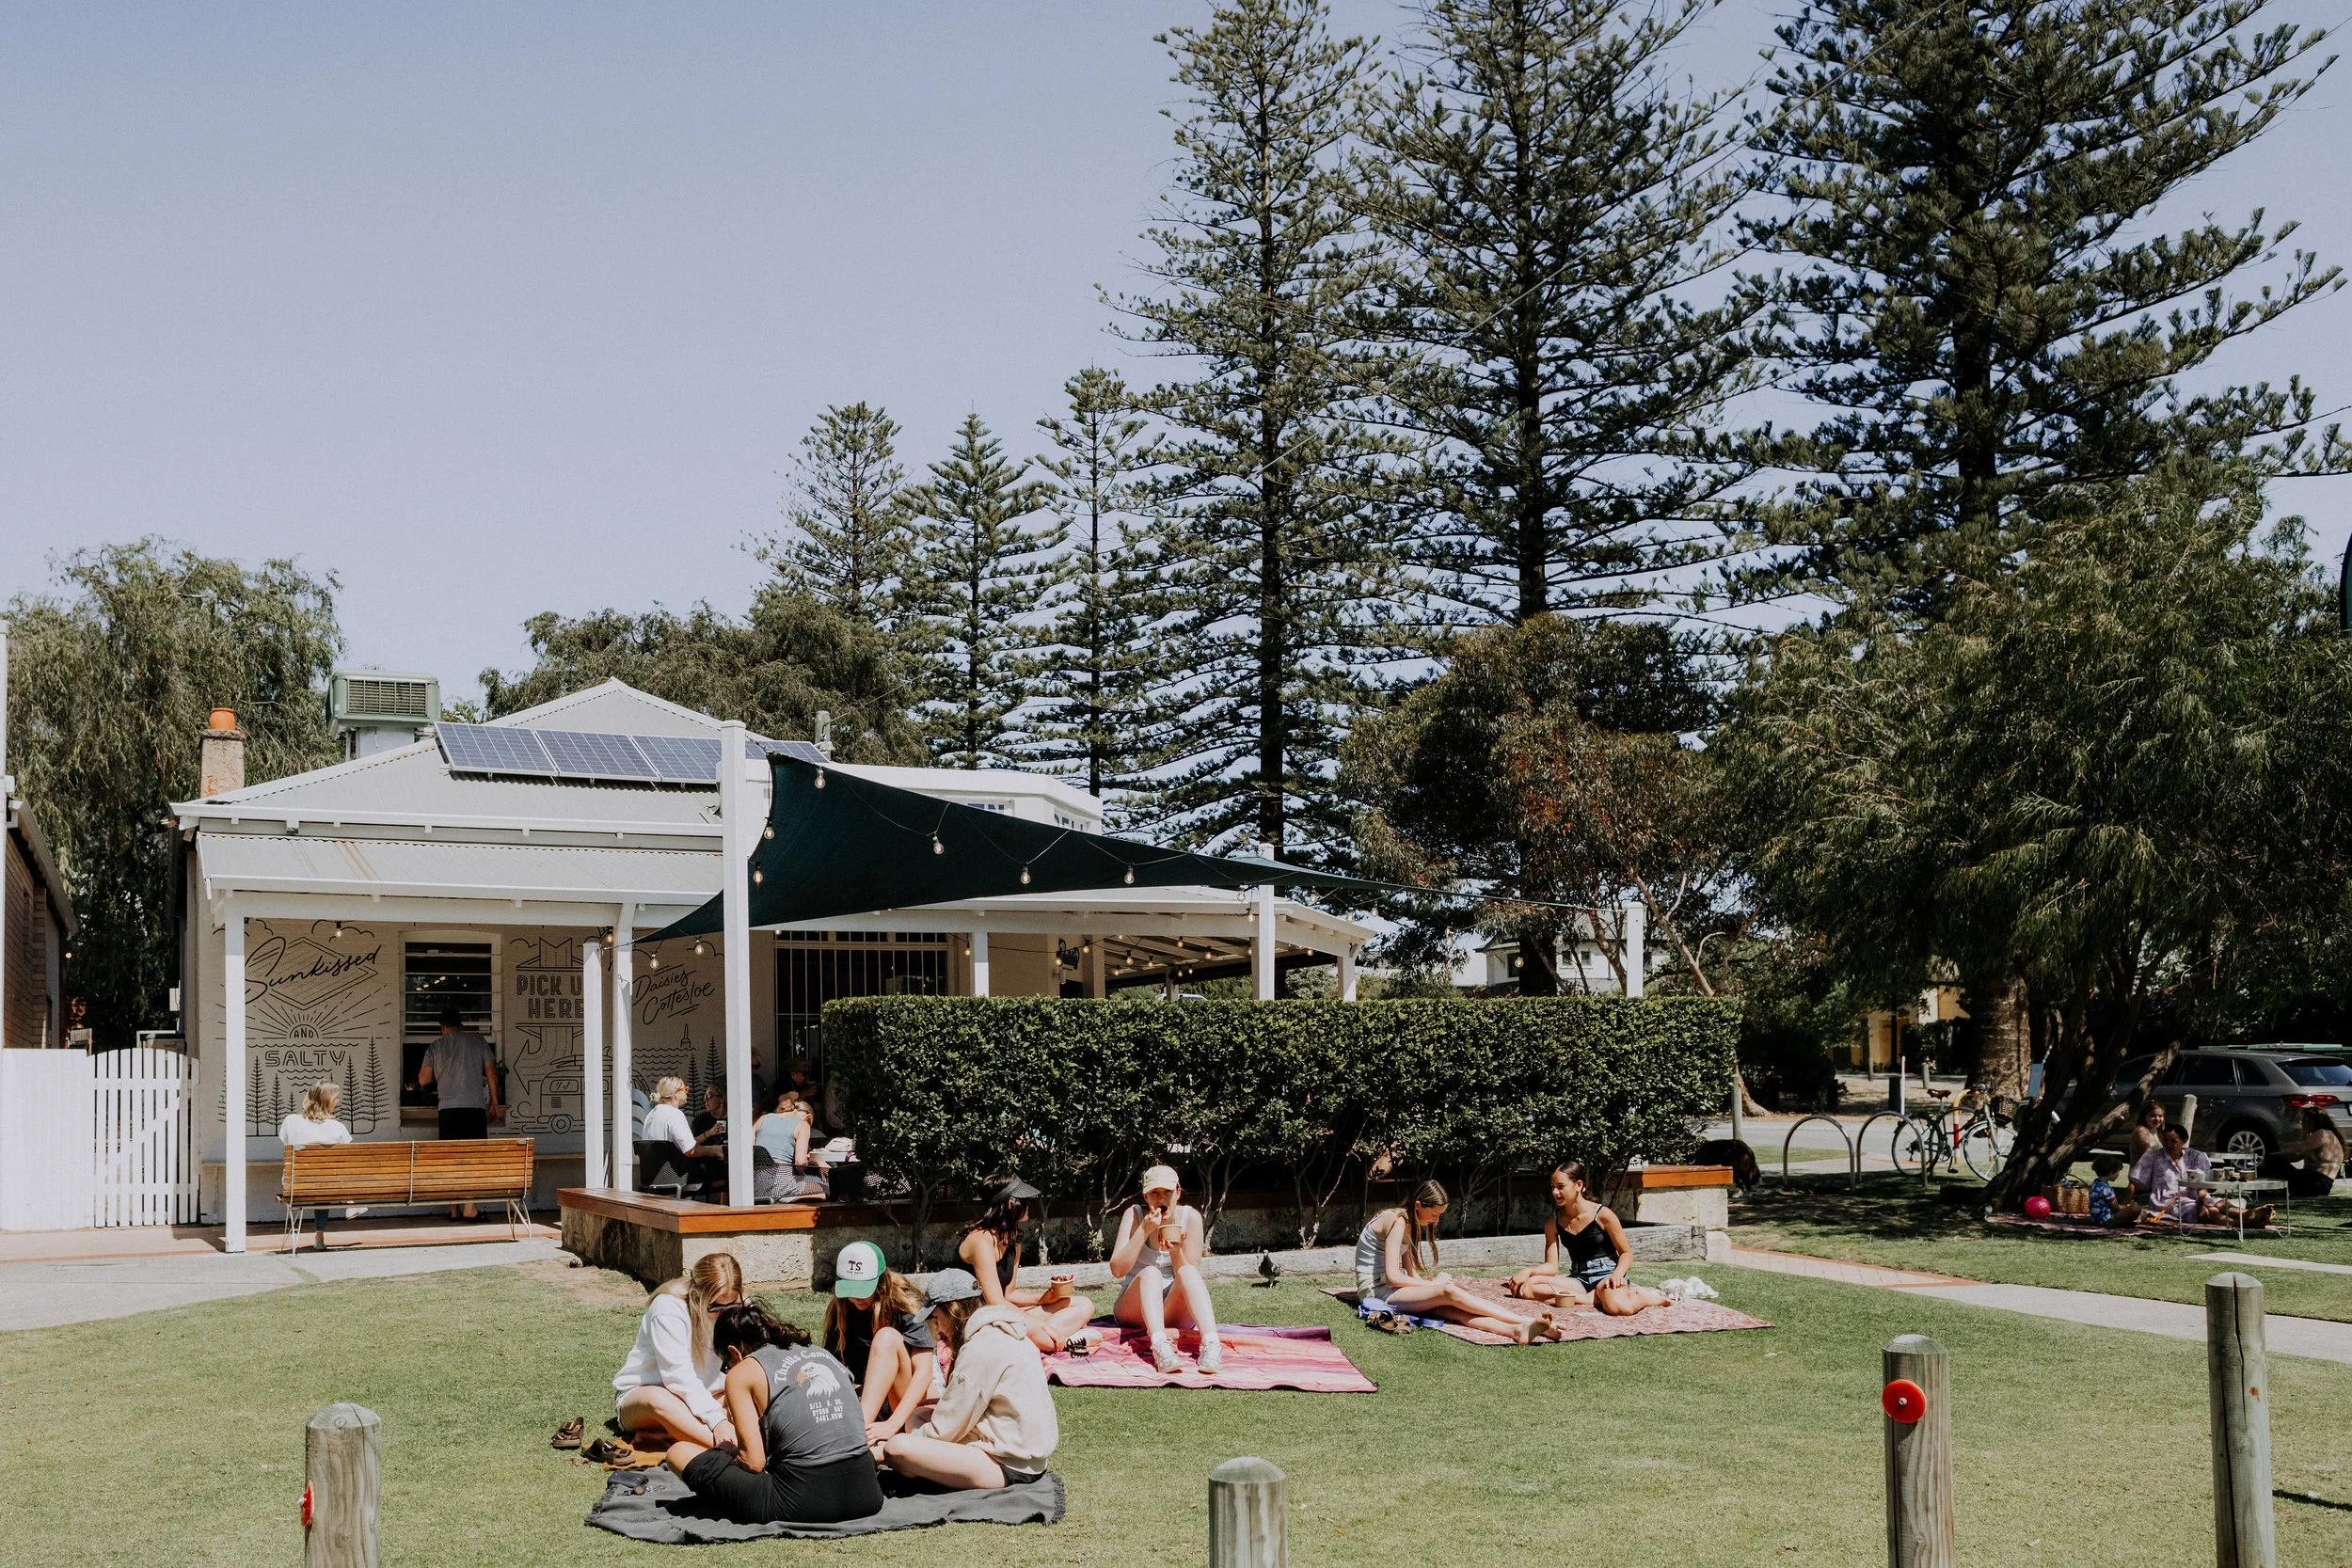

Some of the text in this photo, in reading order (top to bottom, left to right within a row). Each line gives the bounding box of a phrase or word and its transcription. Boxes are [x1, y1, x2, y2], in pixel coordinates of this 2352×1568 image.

[245, 936, 381, 1005] Sunkissed
[516, 974, 584, 996] PICK U
[631, 970, 697, 1006] Daisies
[528, 998, 584, 1019] HERE
[643, 981, 715, 1024] Cottesloe
[294, 1027, 314, 1038] AND
[265, 1050, 346, 1067] SALTY
[848, 1259, 863, 1271] TS
[774, 1350, 847, 1385] Thrills Comp
